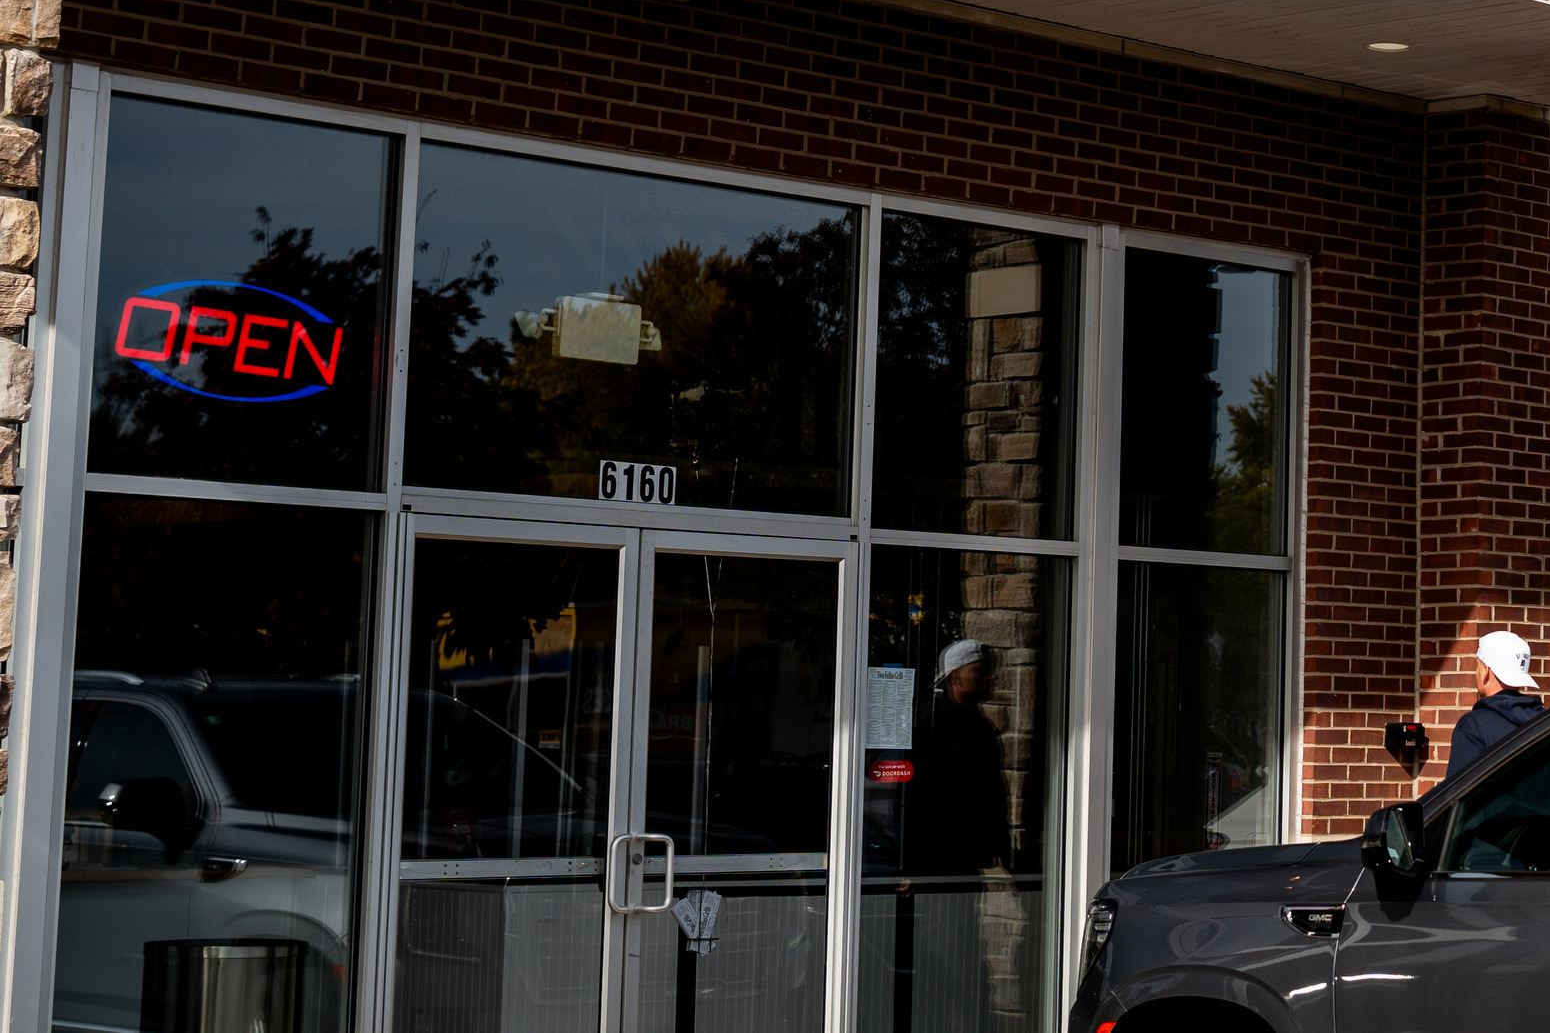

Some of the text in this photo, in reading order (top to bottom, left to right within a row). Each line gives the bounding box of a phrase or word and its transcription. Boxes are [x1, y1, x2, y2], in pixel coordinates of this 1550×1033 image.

[115, 296, 343, 385] OPEN
[601, 461, 675, 504] 6160
[1308, 913, 1333, 922] GMC
